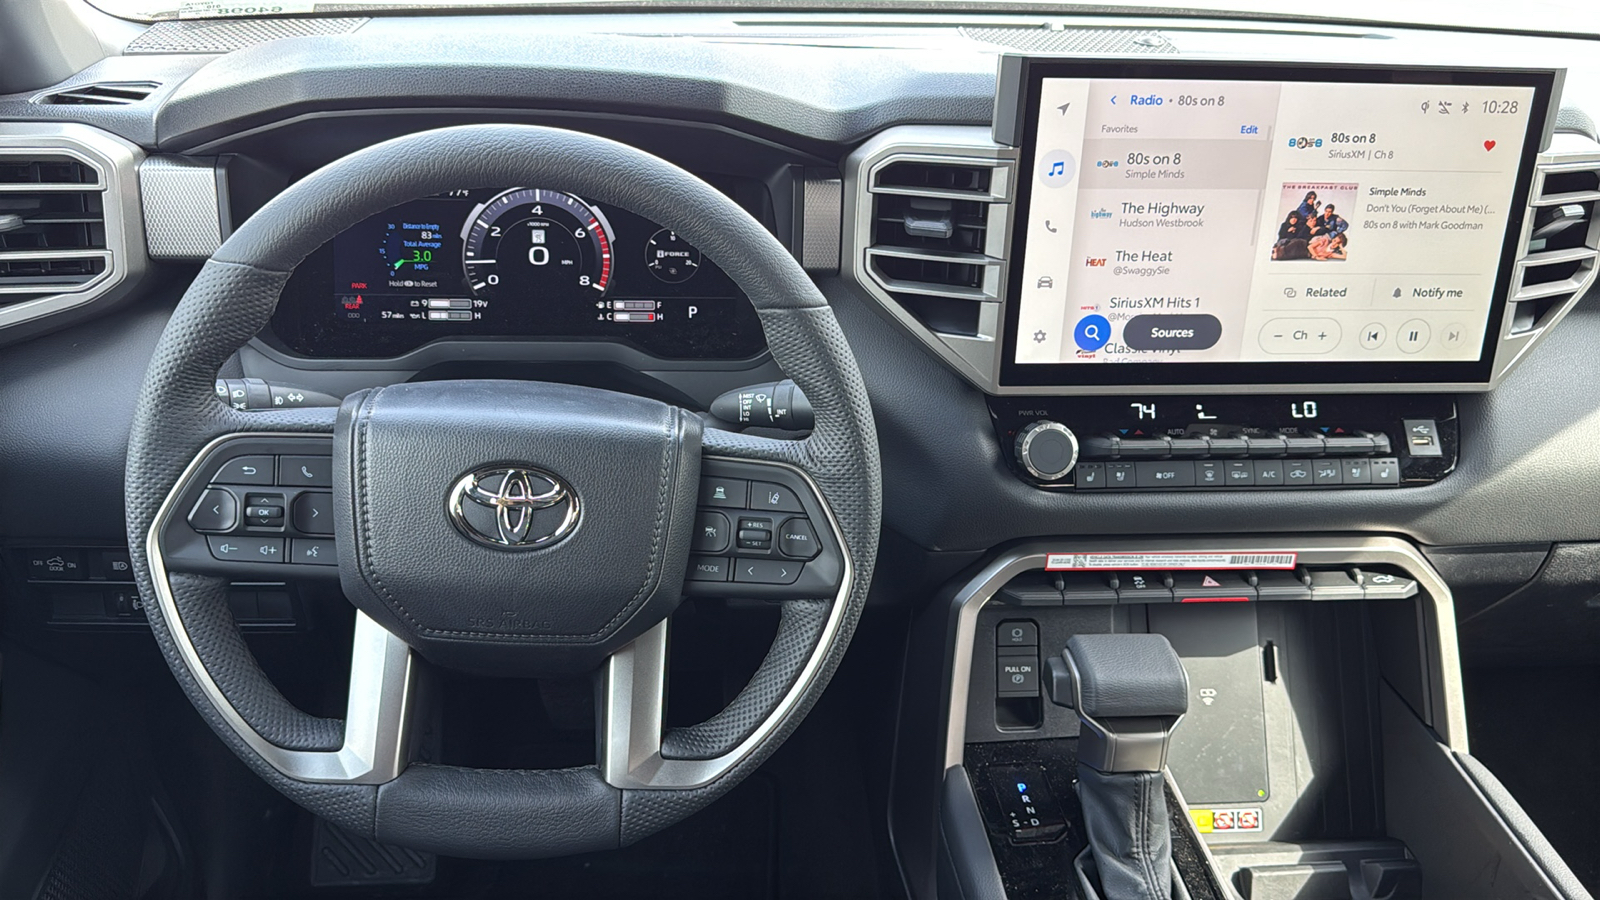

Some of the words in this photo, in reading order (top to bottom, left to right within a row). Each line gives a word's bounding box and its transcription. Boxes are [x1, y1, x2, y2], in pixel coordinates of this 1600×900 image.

[1130, 95, 1163, 106] Radio
[1177, 95, 1198, 107] 80s
[1200, 98, 1214, 107] on
[1217, 96, 1225, 107] 8
[1482, 100, 1519, 114] 10:28
[1101, 124, 1138, 134] Favorites
[1240, 125, 1258, 135] Edit
[1331, 132, 1350, 143] 80s
[1352, 135, 1367, 143] on
[1369, 133, 1376, 143] 8
[1127, 153, 1150, 165] 80s
[1153, 155, 1170, 165] on
[1173, 153, 1181, 165] 8
[1328, 149, 1366, 160] SiriusXM
[1374, 150, 1387, 160] Ch
[1388, 150, 1394, 160] 8
[1125, 169, 1156, 180] Simple
[1158, 170, 1185, 179] Minds
[1369, 187, 1399, 198] Simple
[1400, 188, 1426, 197] Minds
[531, 205, 543, 215] 4
[1121, 202, 1144, 214] The
[1147, 203, 1205, 217] Highway
[1366, 204, 1389, 213] Don't
[1391, 204, 1407, 213] You
[1408, 204, 1438, 215] (Forget
[1439, 205, 1466, 214] About
[1467, 206, 1483, 214] Me)
[1119, 219, 1154, 227] Hudson
[1156, 219, 1204, 227] Westbrook
[1363, 220, 1378, 229] 80s
[1393, 221, 1398, 229] 8
[1399, 221, 1418, 229] with
[1418, 221, 1440, 229] Mark
[1441, 221, 1483, 230] Goodman
[421, 231, 432, 239] 83
[490, 226, 501, 237] 2
[574, 228, 586, 238] 6
[413, 250, 432, 262] 3.0
[528, 246, 550, 265] 0
[1116, 250, 1138, 262] The
[1141, 250, 1173, 262] Heat
[1085, 258, 1107, 267] HEAT
[1113, 266, 1170, 277] @SwaggySie
[487, 274, 499, 285] 0
[579, 275, 590, 286] 8
[1306, 287, 1347, 298] Related
[1412, 288, 1445, 299] Notify
[473, 300, 488, 308] 19V
[1110, 297, 1164, 309] SiriusXM
[1167, 297, 1191, 308] Hits
[1195, 297, 1200, 308] 1
[421, 311, 427, 319] L
[688, 306, 698, 318] P
[1151, 327, 1194, 338] Sources
[1293, 330, 1308, 340] Ch
[1131, 403, 1156, 419] 74
[1291, 401, 1317, 418] LO
[1162, 471, 1175, 479] OFF
[697, 564, 719, 572] MODE
[467, 618, 494, 629] SRS
[499, 620, 552, 630] AIRBAG
[1017, 783, 1027, 793] P
[1021, 795, 1031, 803] R
[1026, 806, 1036, 814] N
[1012, 819, 1020, 828] S
[1030, 818, 1040, 826] D
